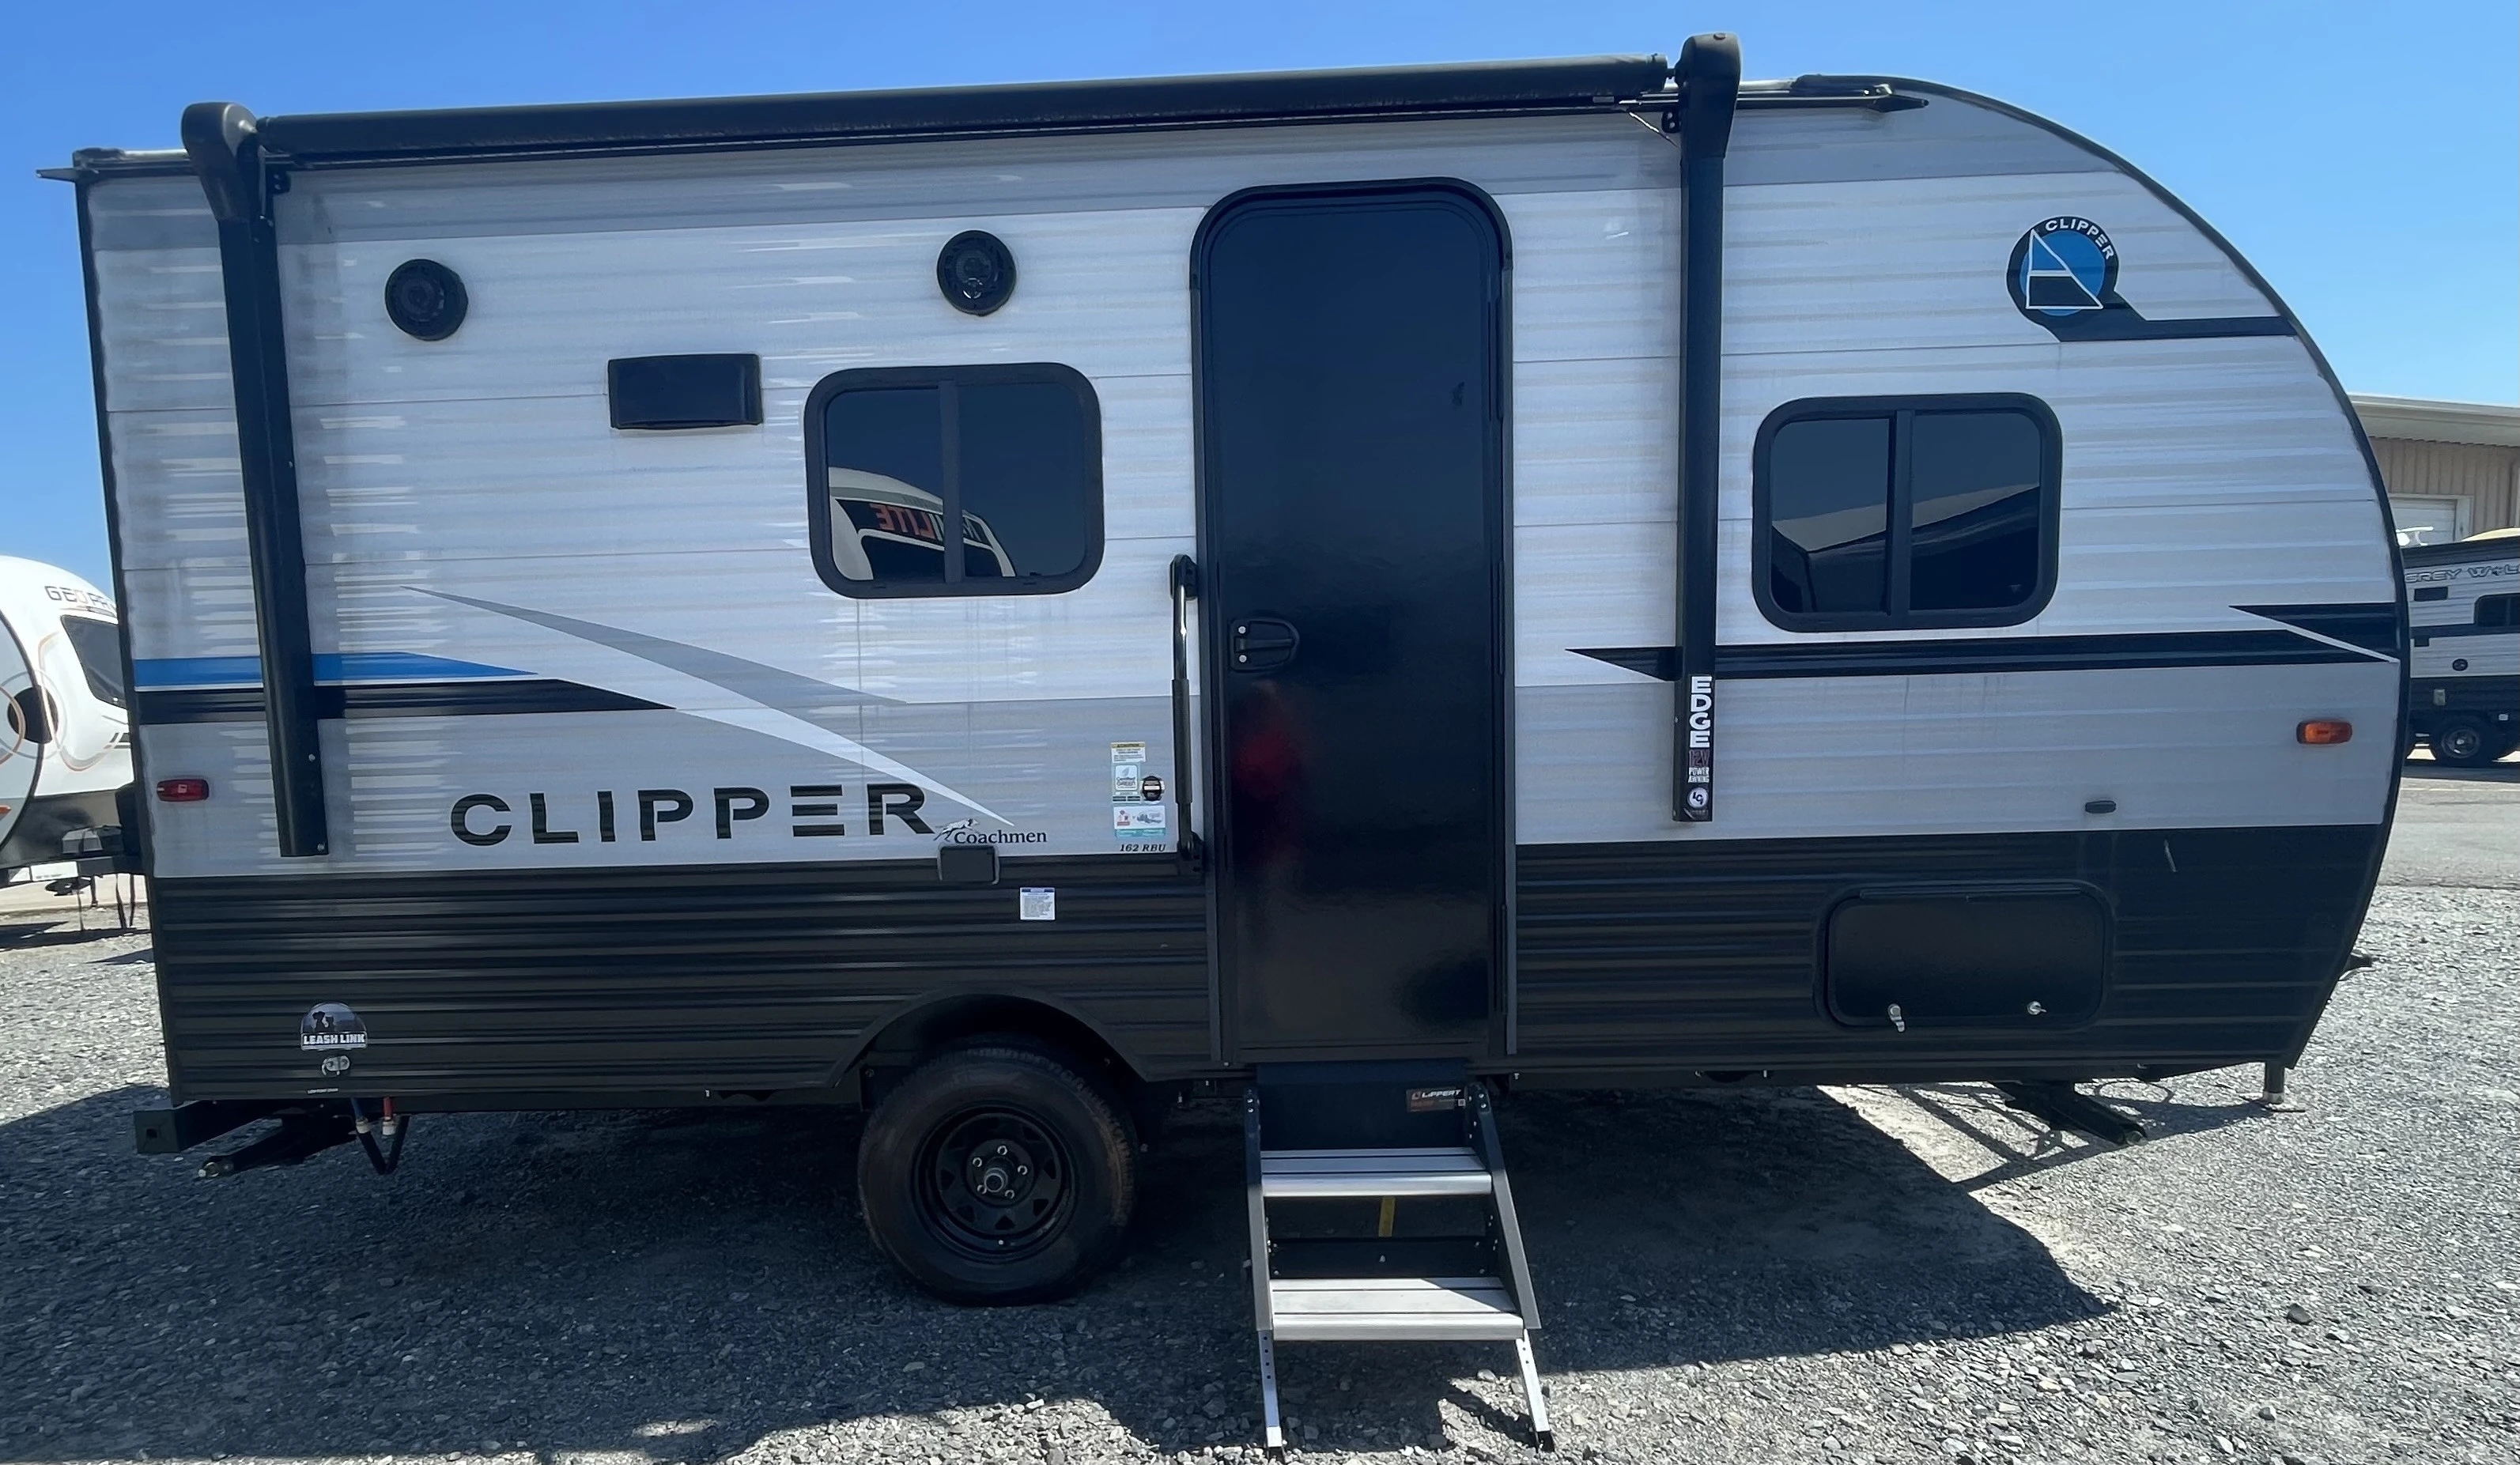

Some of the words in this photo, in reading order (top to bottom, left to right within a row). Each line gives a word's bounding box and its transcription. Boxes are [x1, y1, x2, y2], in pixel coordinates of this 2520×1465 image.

[2046, 218, 2114, 259] CLIPPER
[2405, 568, 2462, 583] GREY
[2467, 564, 2520, 578] WL
[1689, 676, 1713, 748] EDGE
[450, 783, 935, 846] CLIPPER
[954, 829, 1048, 844] Coachmen
[1119, 844, 1139, 852] 162
[1142, 844, 1166, 852] RBU
[303, 1034, 338, 1044] LEASH
[339, 1033, 365, 1044] LINK
[1422, 1089, 1461, 1098] LIPPERT
